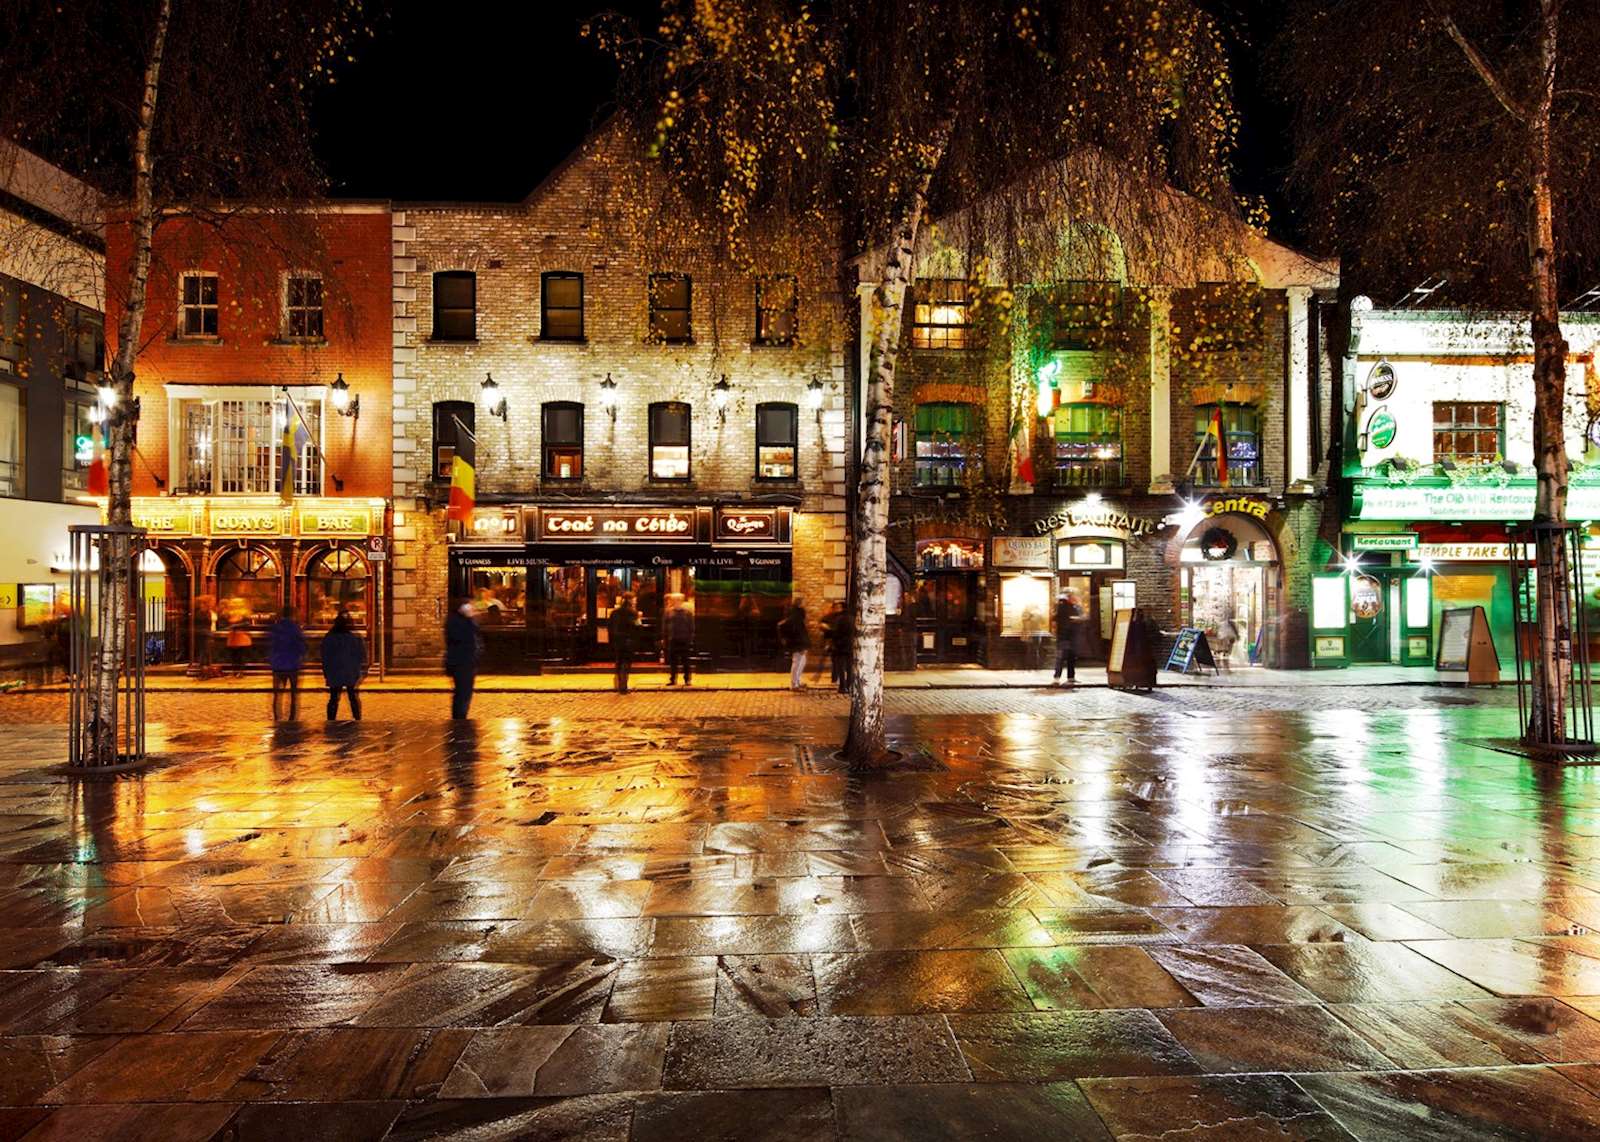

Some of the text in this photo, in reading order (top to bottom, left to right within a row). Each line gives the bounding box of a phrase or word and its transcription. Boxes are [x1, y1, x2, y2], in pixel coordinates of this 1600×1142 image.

[1424, 493, 1444, 505] The
[138, 515, 353, 530] THE QUAYS BAR
[1417, 546, 1462, 558] TEMPLE
[1467, 546, 1498, 558] TAKE
